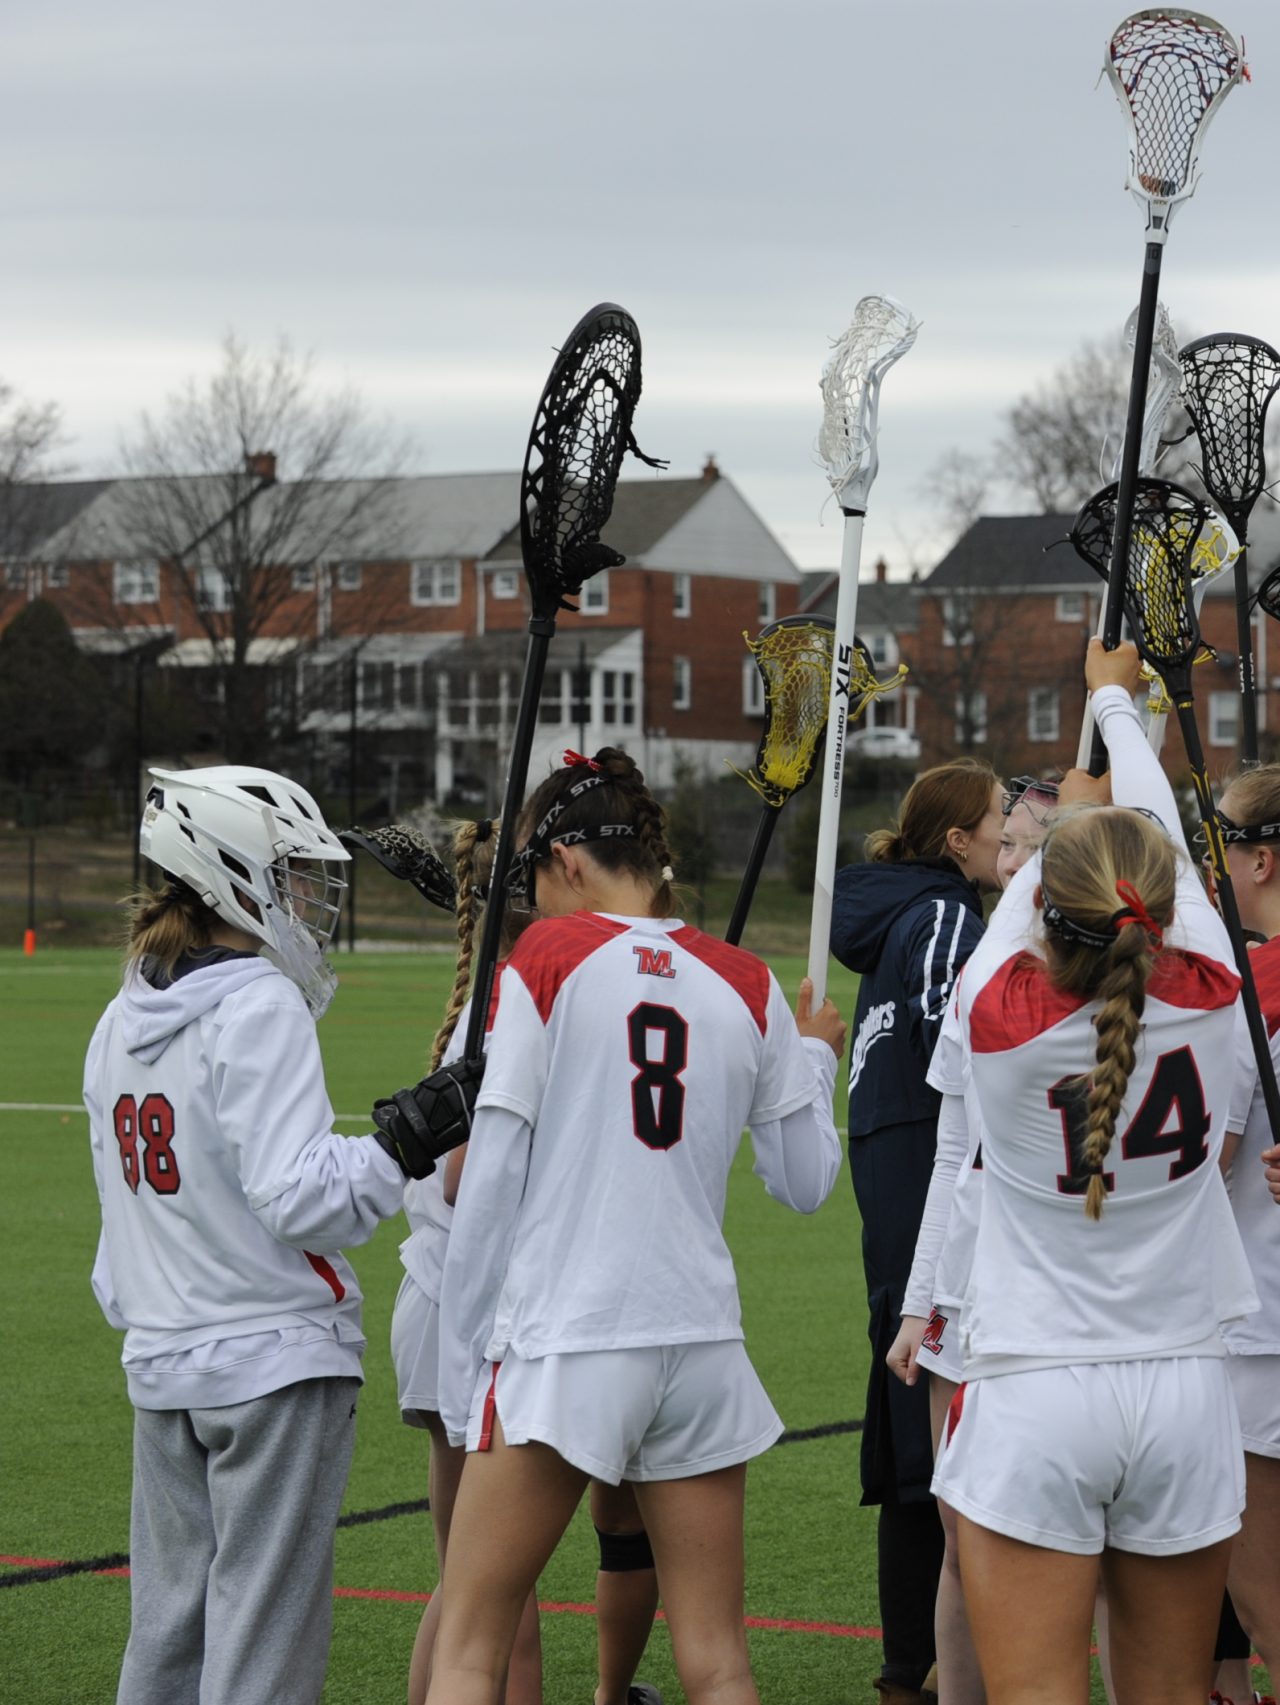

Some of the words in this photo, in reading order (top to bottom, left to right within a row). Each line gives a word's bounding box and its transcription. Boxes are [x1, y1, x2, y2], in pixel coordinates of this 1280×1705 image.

[835, 643, 852, 698] STX
[834, 706, 845, 780] FORTRESS
[570, 776, 604, 797] STX
[537, 801, 565, 838] STX
[599, 824, 634, 837] STX
[627, 1001, 689, 1151] 8
[113, 1093, 181, 1196] 88
[1047, 1043, 1212, 1196] 14
